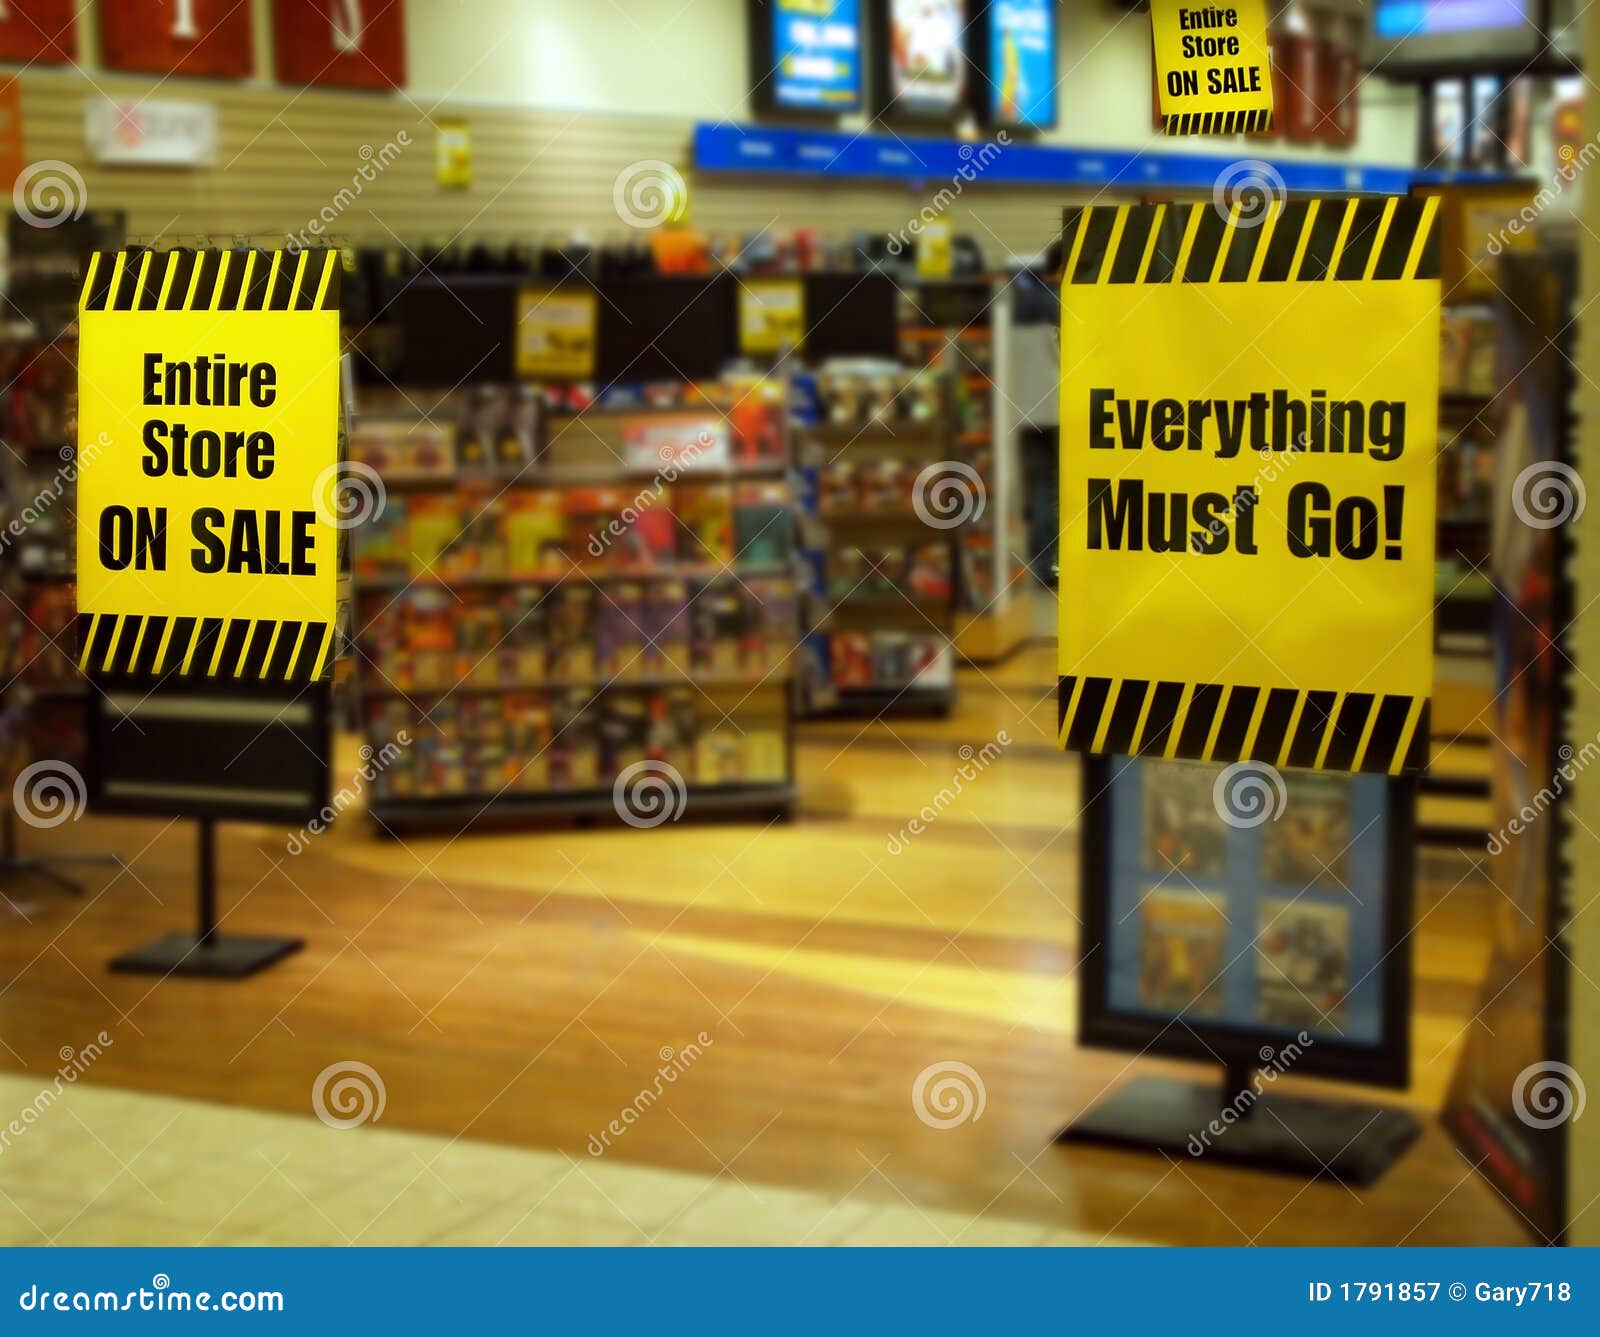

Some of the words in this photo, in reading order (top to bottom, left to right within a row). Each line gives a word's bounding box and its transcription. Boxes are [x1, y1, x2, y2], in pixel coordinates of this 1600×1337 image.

[1179, 6, 1238, 31] Entire
[1181, 35, 1240, 60] Store
[1167, 70, 1199, 97] ON
[1207, 66, 1261, 95] SALE
[143, 353, 277, 408] Entire
[142, 419, 275, 480] Store
[1089, 388, 1406, 462] Everything
[99, 505, 167, 571] ON
[191, 507, 316, 576] SALE
[1087, 478, 1259, 555] Must
[1287, 481, 1405, 561] Go!
